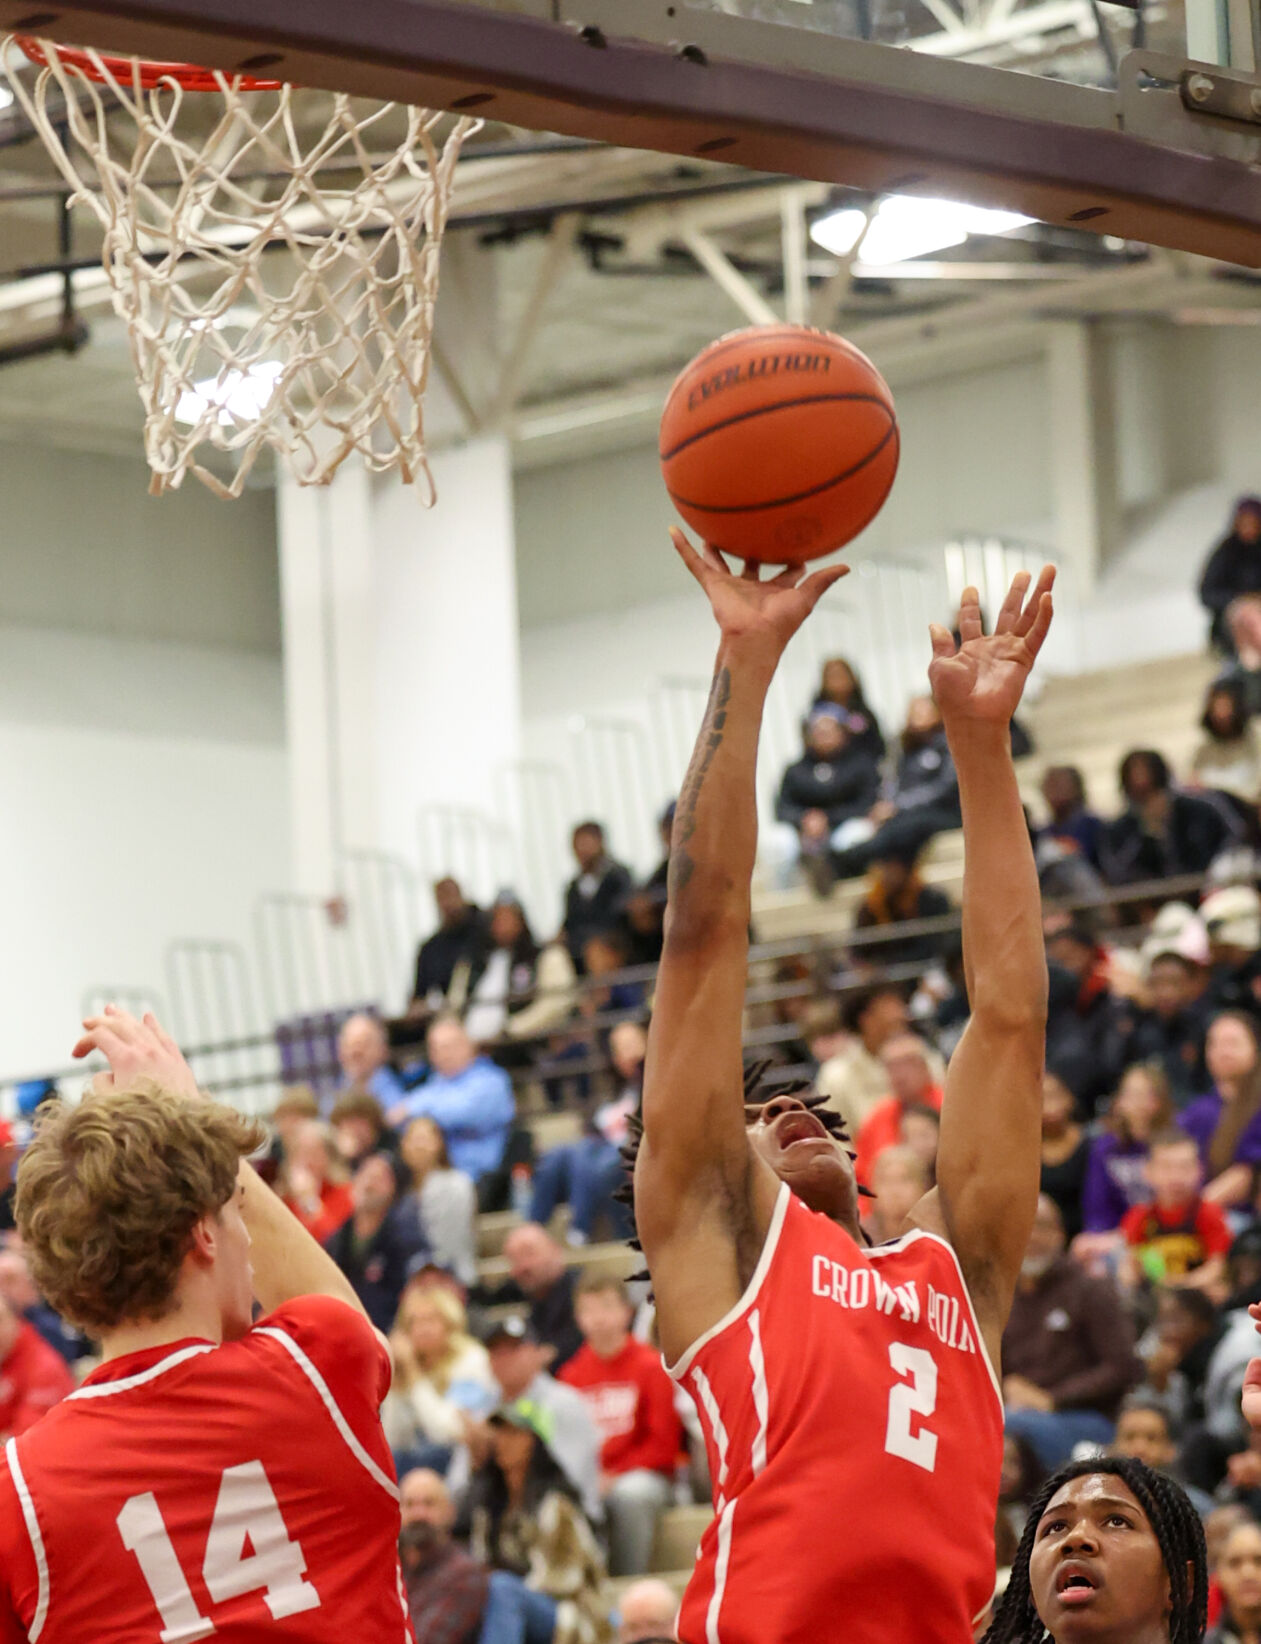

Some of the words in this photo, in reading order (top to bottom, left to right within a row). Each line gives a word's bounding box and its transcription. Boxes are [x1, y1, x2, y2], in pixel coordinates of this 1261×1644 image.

[812, 1254, 920, 1324] CROWN
[885, 1341, 938, 1473] 2
[115, 1459, 321, 1644] 14
